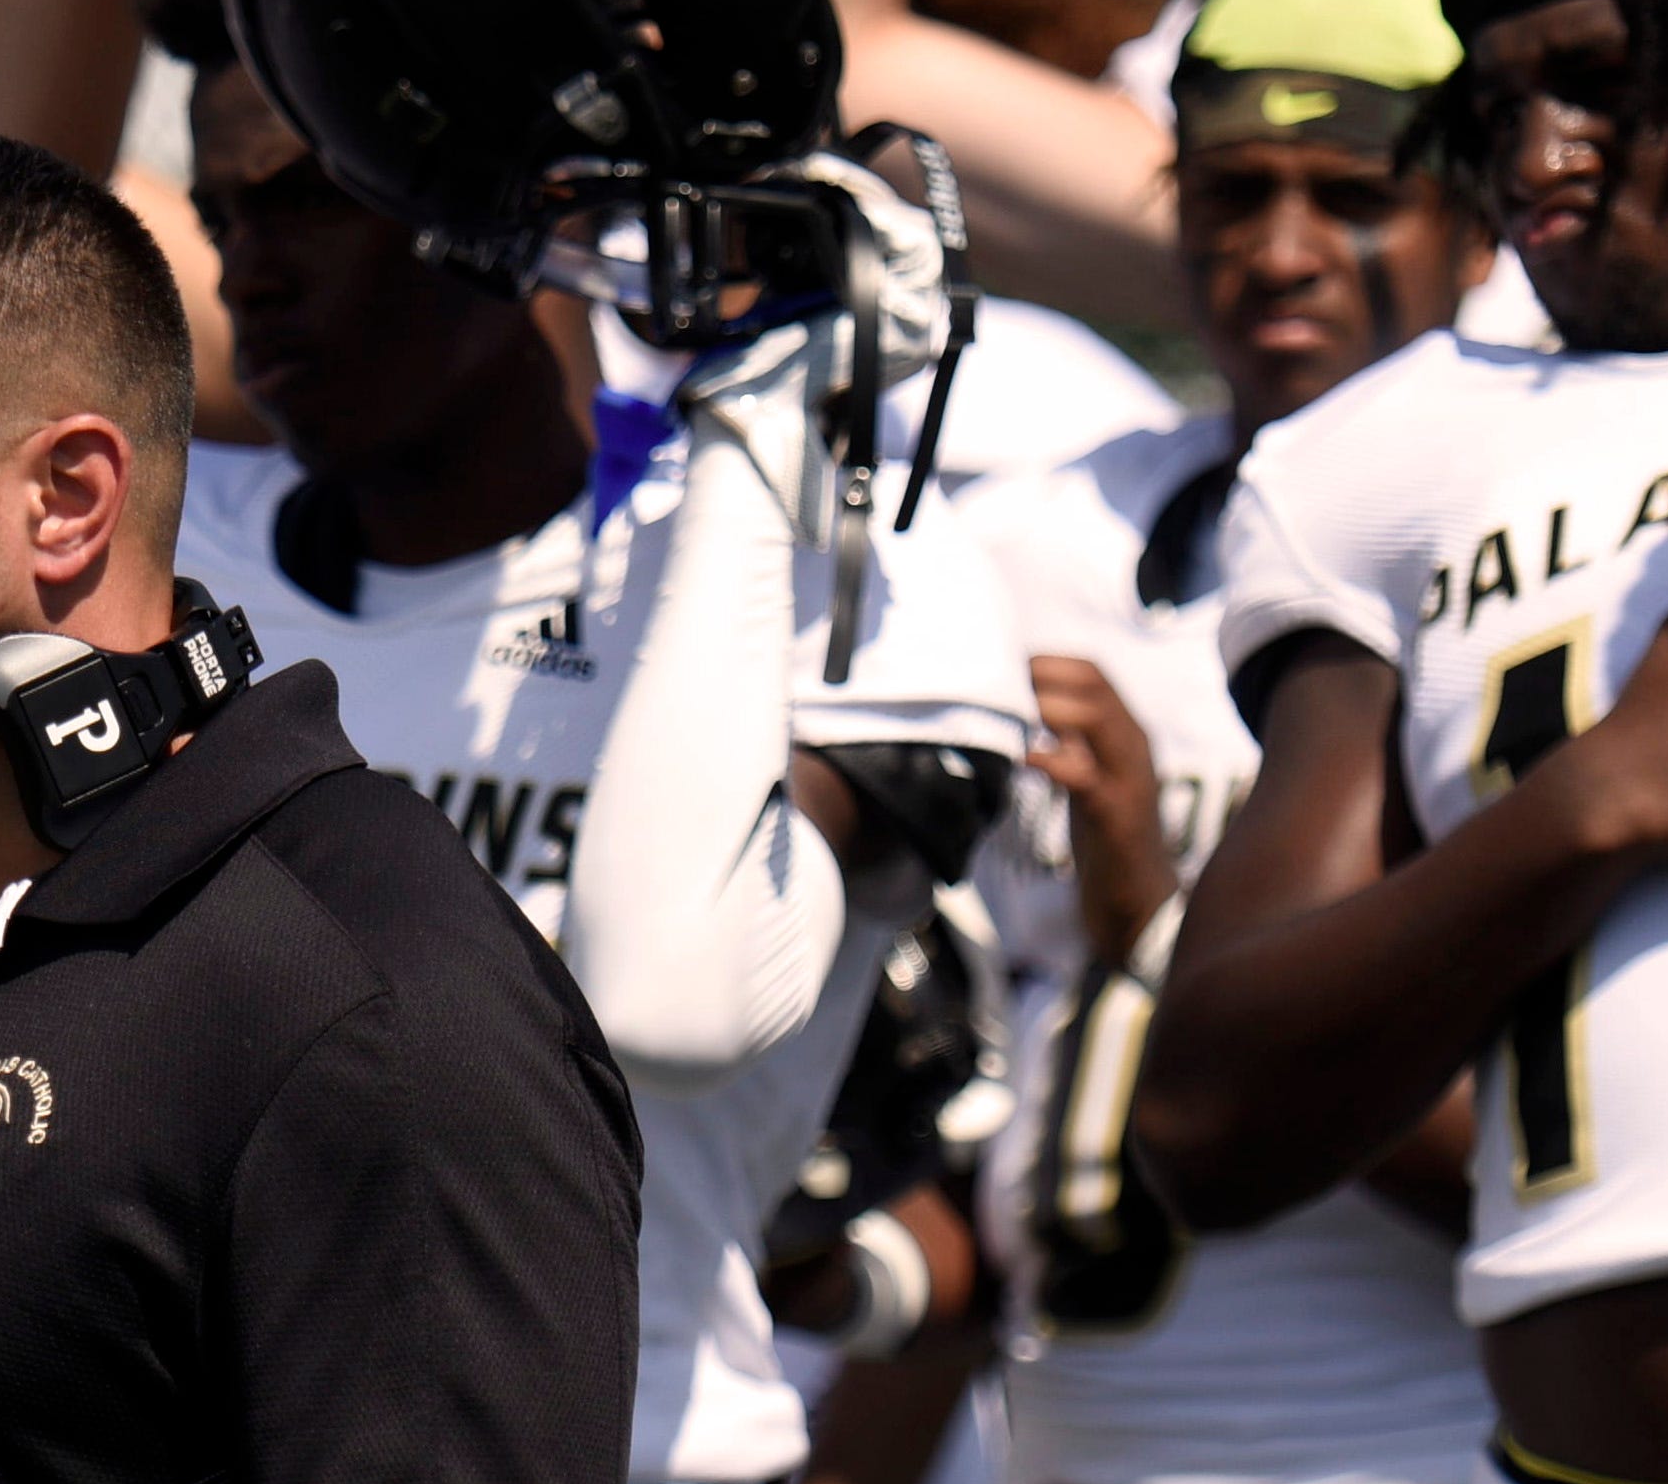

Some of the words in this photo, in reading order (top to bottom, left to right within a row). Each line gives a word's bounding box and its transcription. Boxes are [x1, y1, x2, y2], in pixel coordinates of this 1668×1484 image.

[183, 638, 217, 698] PHONE
[195, 631, 227, 694] PORTA
[490, 643, 597, 683] adidas
[45, 698, 121, 753] P
[18, 1060, 53, 1144] CATHOLIC
